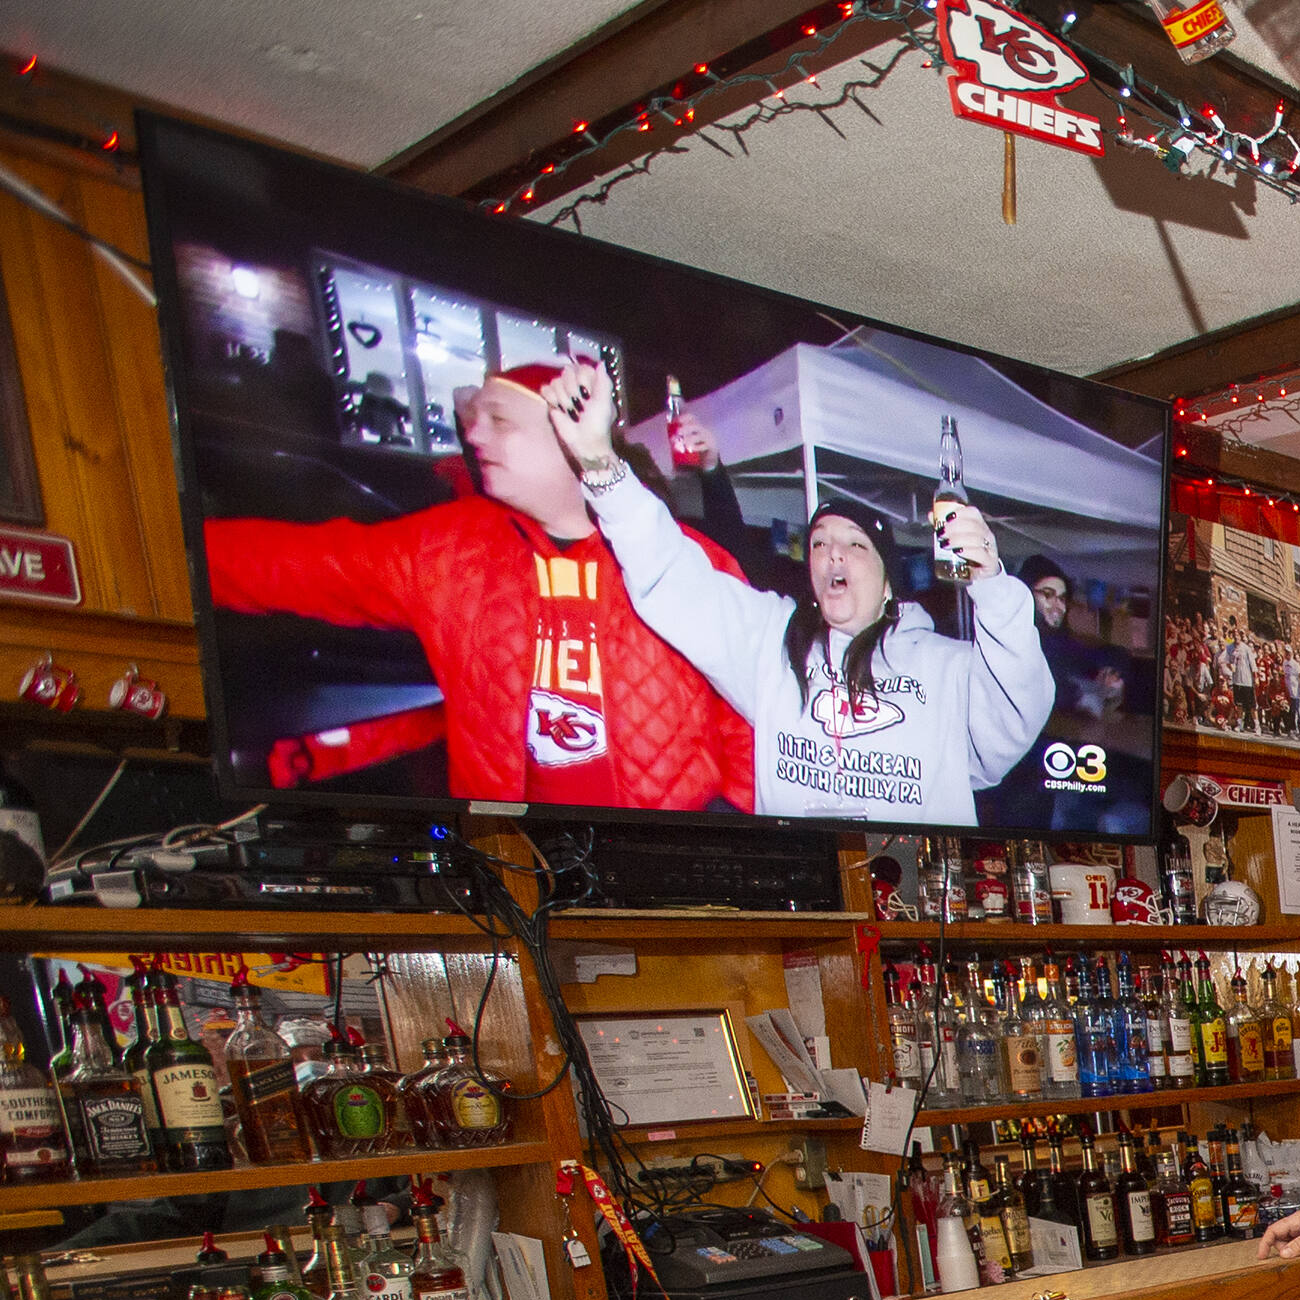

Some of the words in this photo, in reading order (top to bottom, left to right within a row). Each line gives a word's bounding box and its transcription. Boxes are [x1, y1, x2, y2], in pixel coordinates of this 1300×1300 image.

[974, 15, 1058, 83] KC
[956, 82, 1100, 146] CHIEFS
[0, 547, 46, 581] VE
[777, 731, 817, 764] 11TH
[819, 745, 836, 767] &
[1076, 744, 1107, 780] 3
[776, 758, 831, 794] SOUTH
[898, 781, 923, 806] PA
[1044, 779, 1107, 794] CBSPhilly.com
[1227, 785, 1283, 805] CHIEFS
[1089, 882, 1109, 910] 11
[162, 1069, 214, 1085] JAMESO
